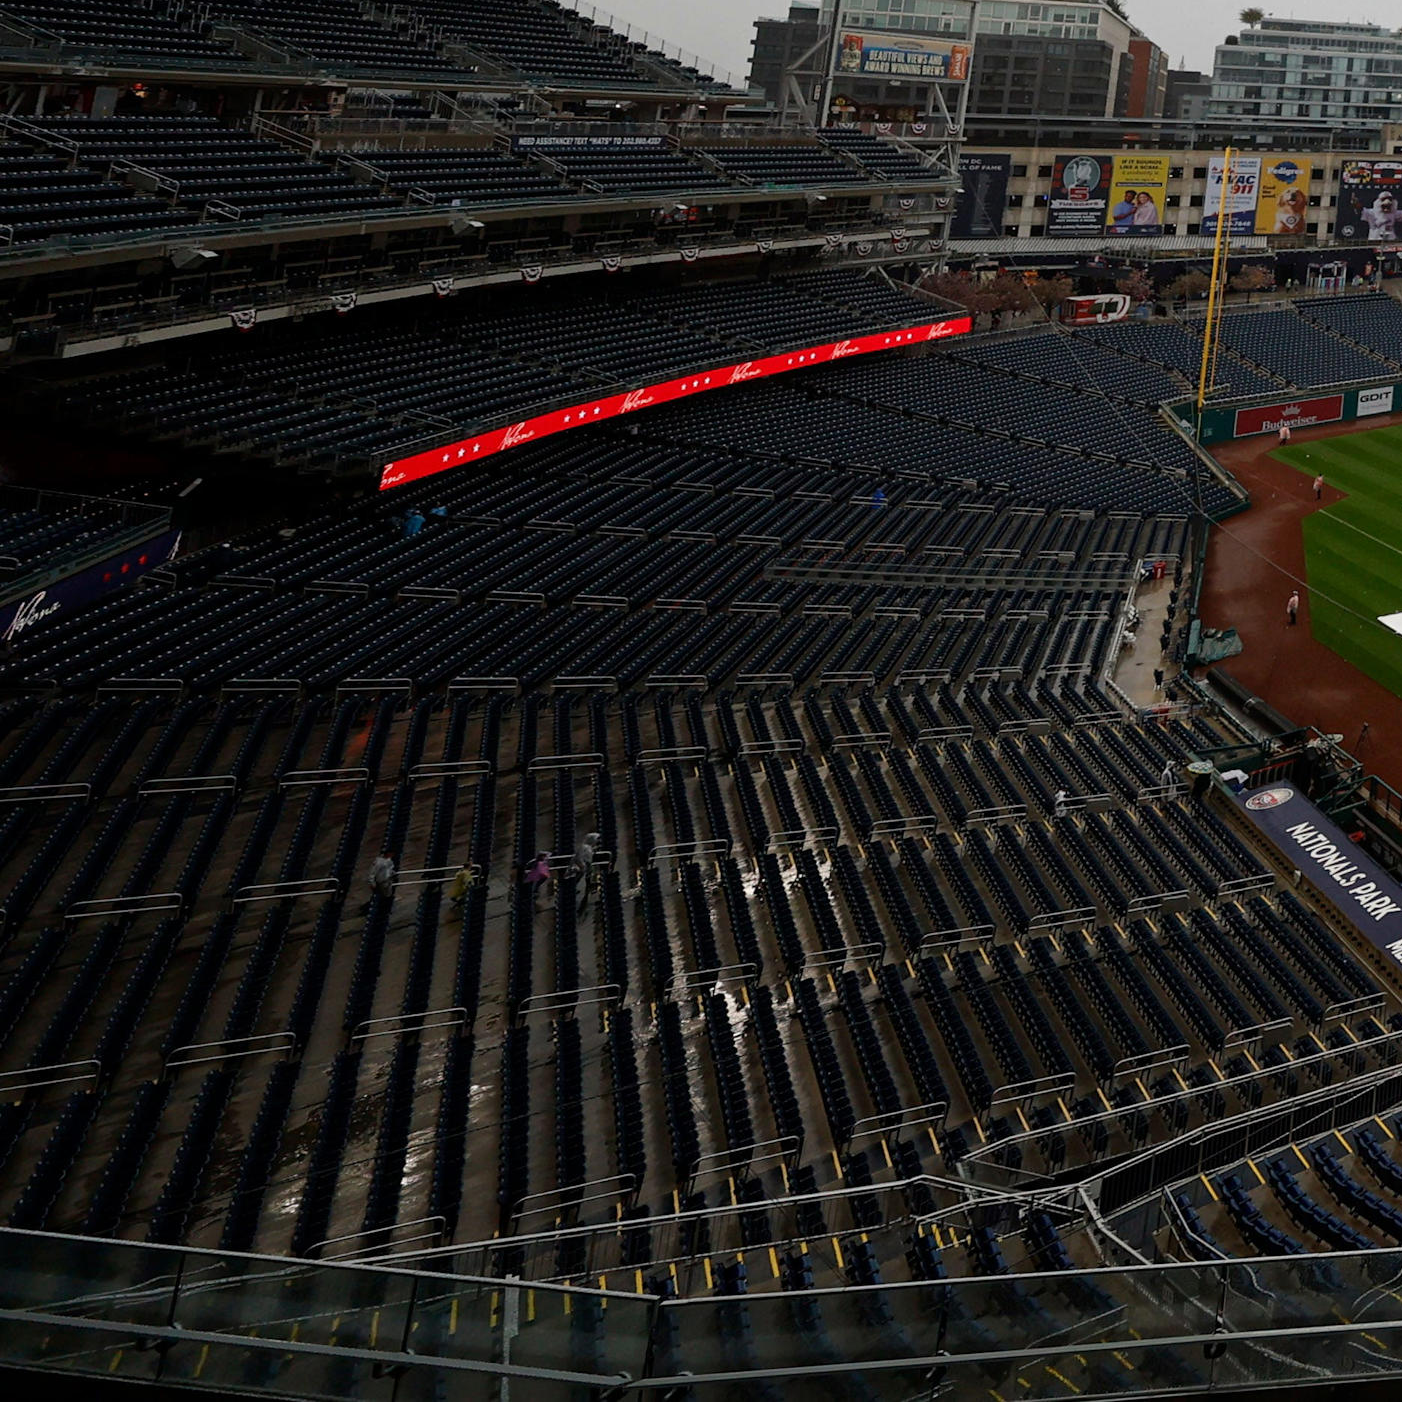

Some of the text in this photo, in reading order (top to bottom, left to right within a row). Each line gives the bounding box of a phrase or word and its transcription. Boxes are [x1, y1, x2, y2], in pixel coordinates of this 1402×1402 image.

[907, 52, 929, 65] VIEWS
[929, 54, 943, 66] AND
[863, 61, 891, 73] AWARD
[922, 65, 945, 77] BREWS
[519, 137, 535, 145] NEED
[574, 137, 588, 145] TEXT
[1231, 185, 1253, 194] 911
[1360, 391, 1392, 403] GDIT
[1262, 415, 1317, 431] Budweiser
[1285, 821, 1402, 921] NATIONALS PARK
